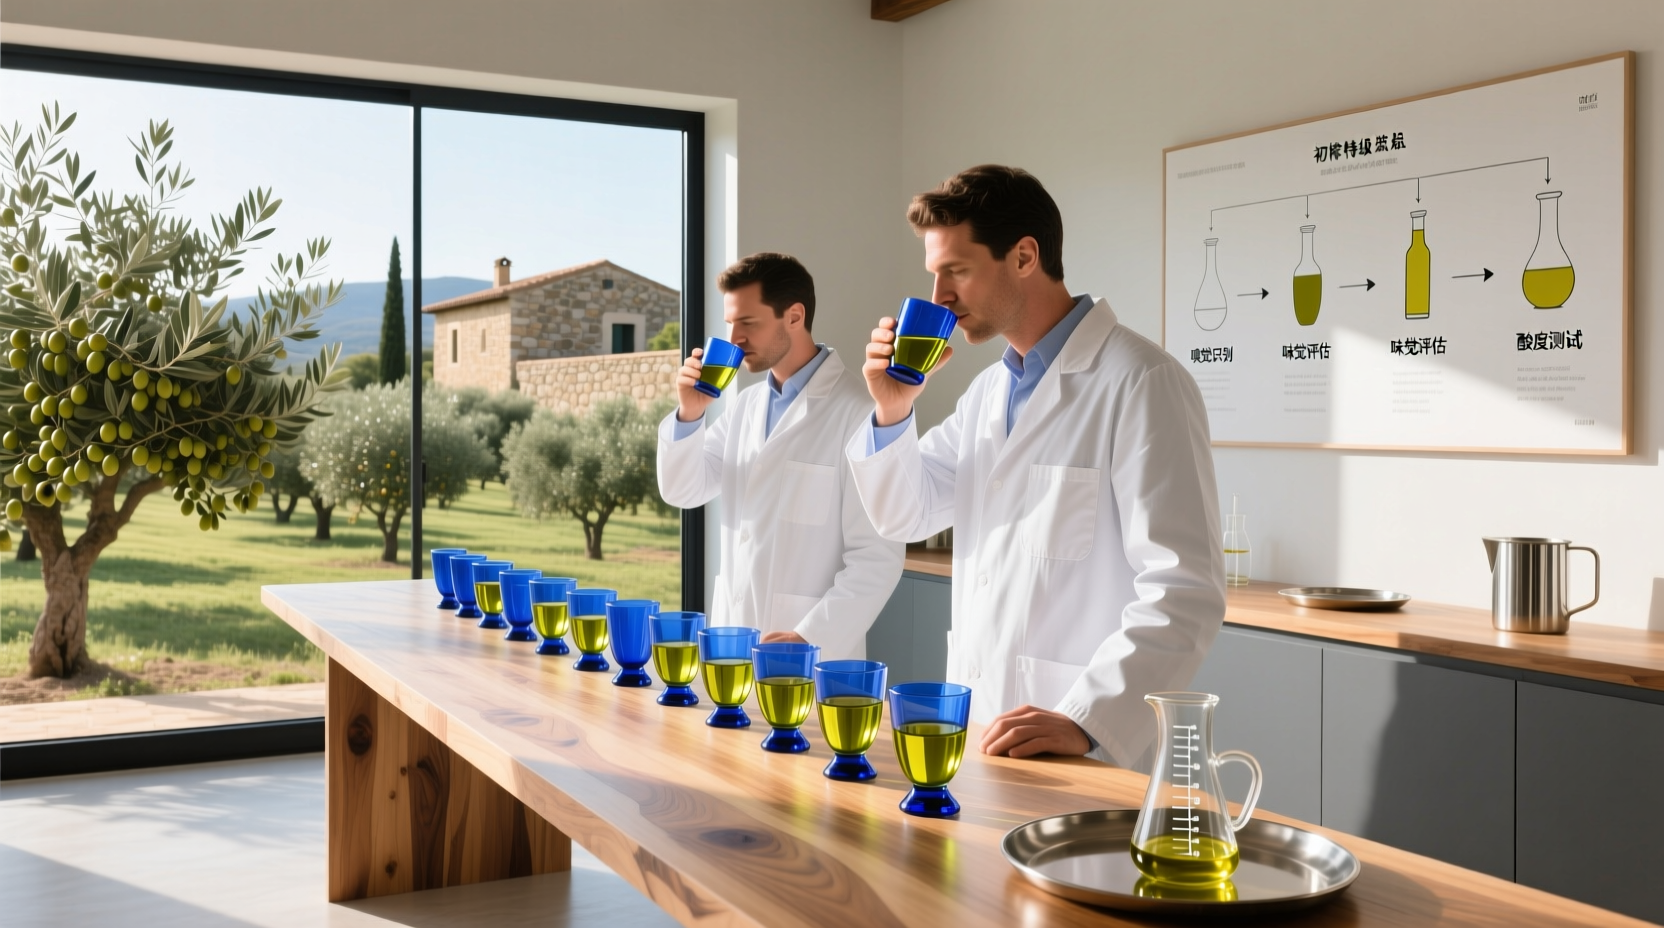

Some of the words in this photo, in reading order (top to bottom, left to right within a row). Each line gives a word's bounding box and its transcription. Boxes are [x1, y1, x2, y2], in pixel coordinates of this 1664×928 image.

[1390, 335, 1447, 356] 味觉评估
[1515, 329, 1583, 352] 酸度测试
